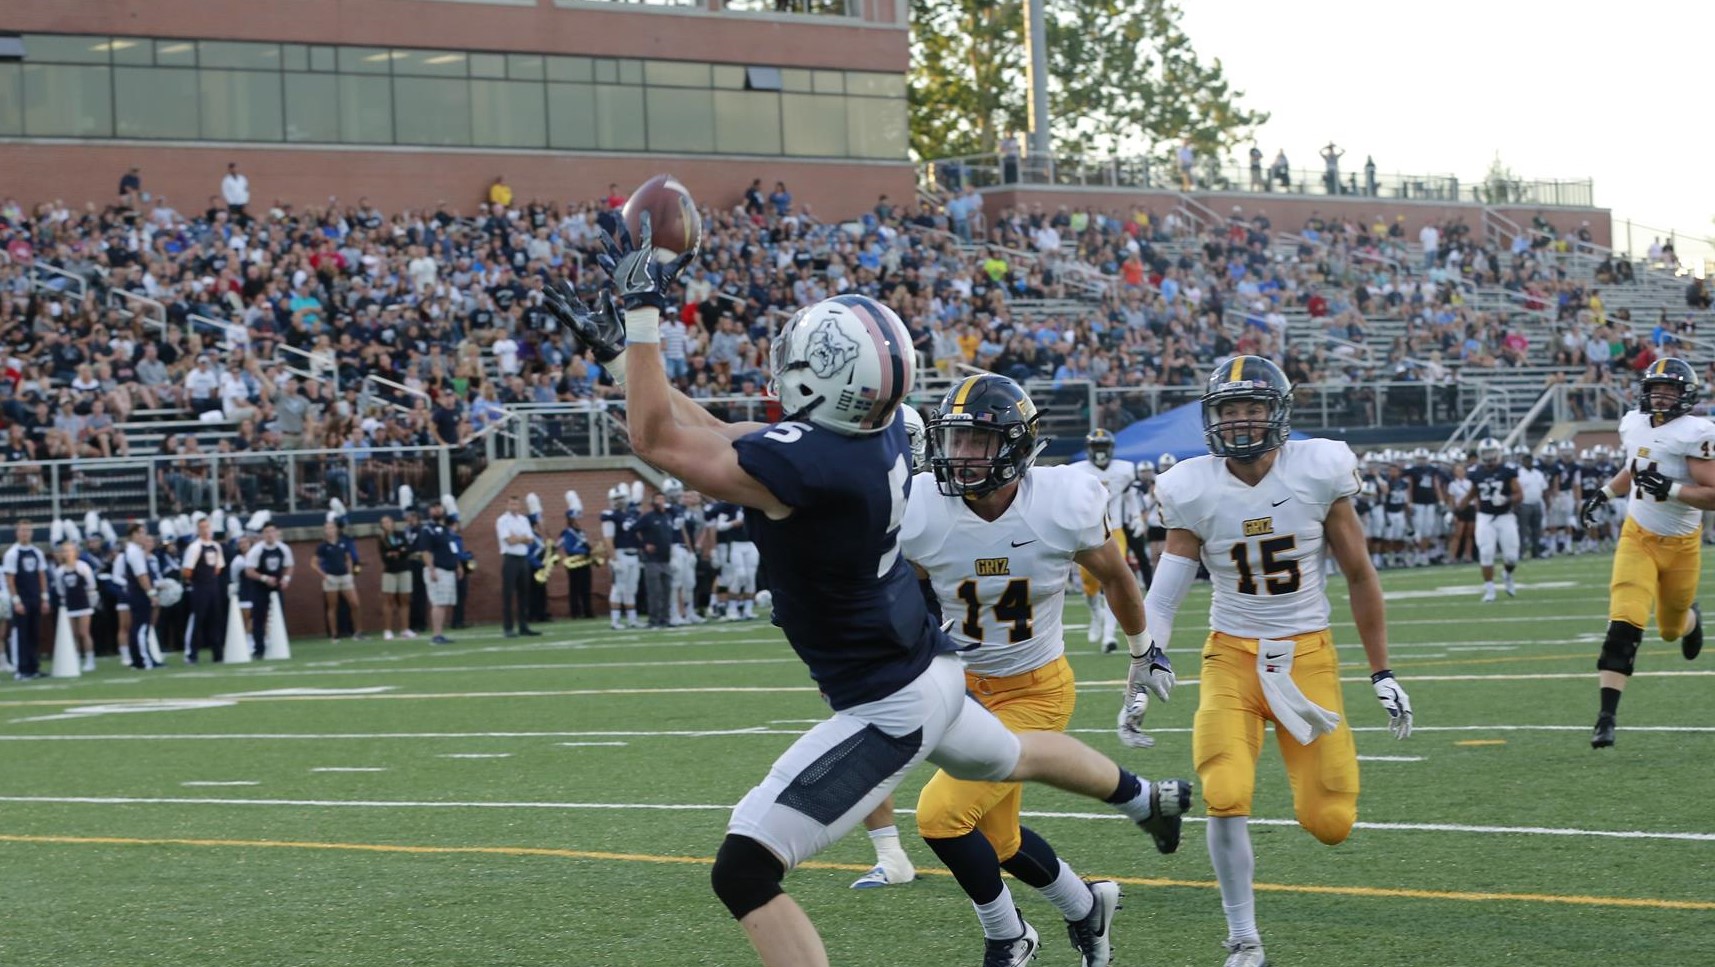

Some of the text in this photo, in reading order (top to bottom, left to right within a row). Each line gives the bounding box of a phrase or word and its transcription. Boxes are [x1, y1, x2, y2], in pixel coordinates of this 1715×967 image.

[763, 421, 814, 443] 5
[1701, 440, 1715, 457] 4
[975, 557, 1010, 576] GRIZ
[1229, 533, 1303, 595] 15
[957, 578, 1034, 644] 14
